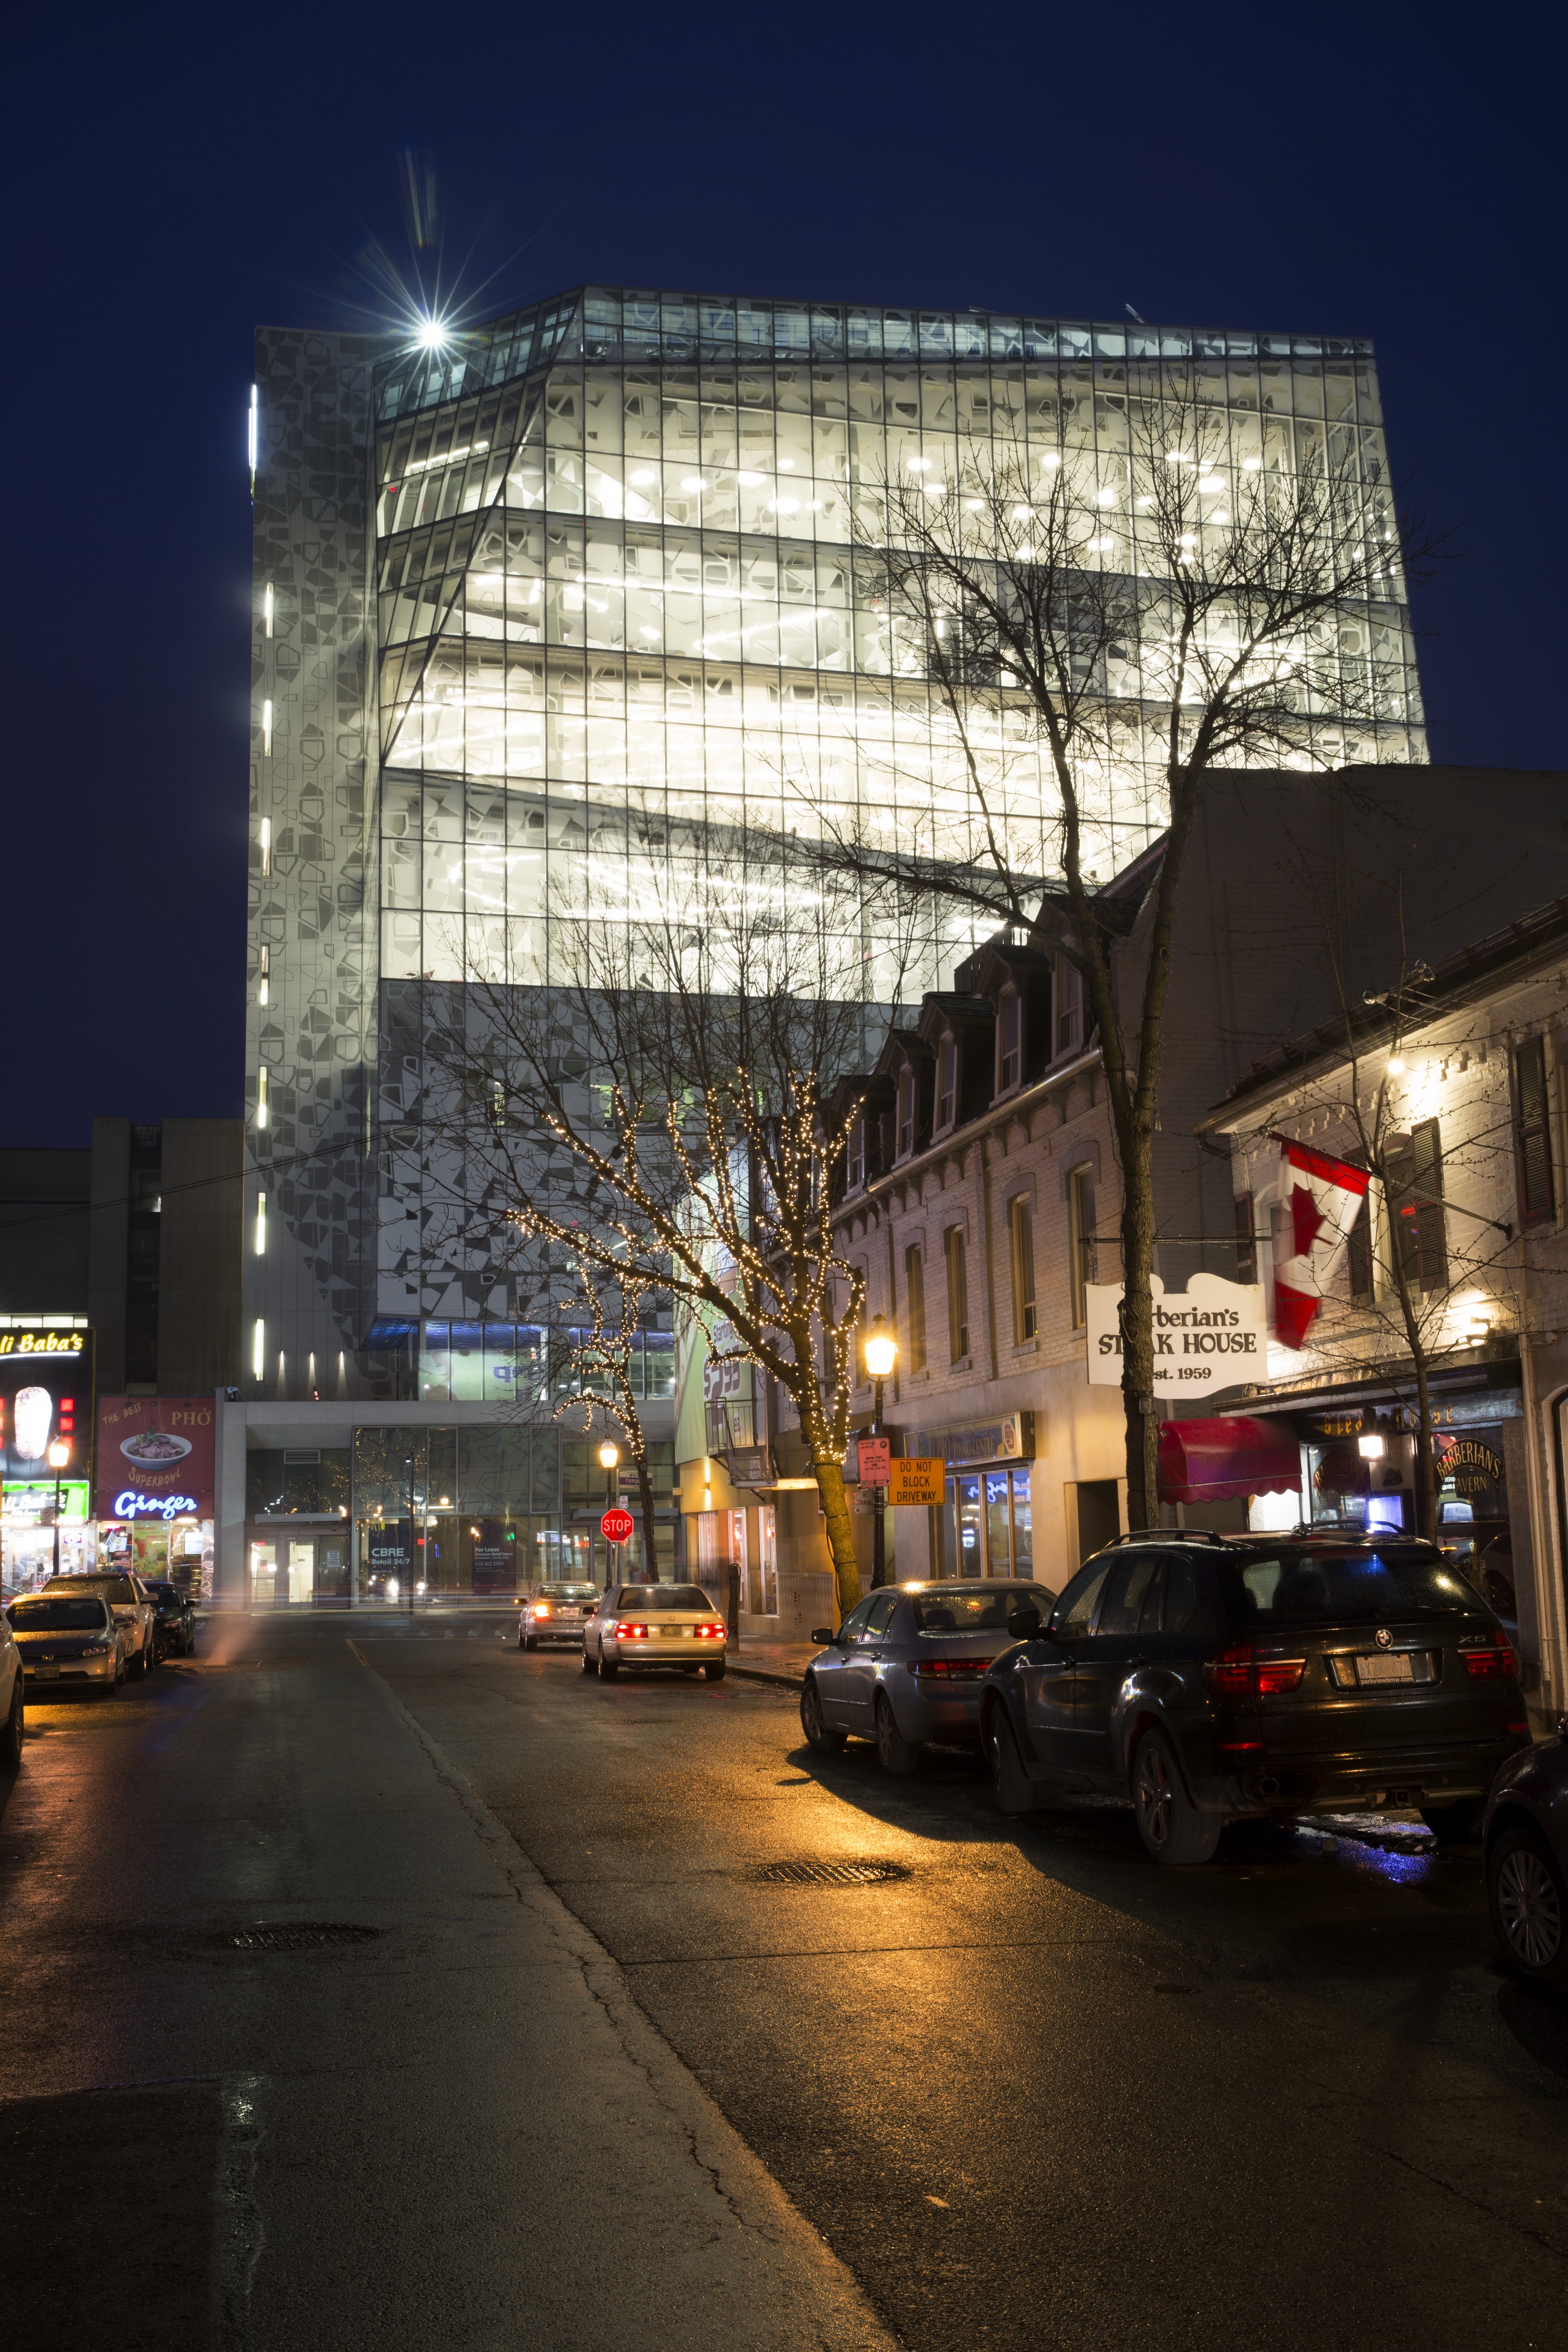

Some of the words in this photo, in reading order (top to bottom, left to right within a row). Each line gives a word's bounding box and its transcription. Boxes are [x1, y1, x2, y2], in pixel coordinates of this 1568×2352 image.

[1152, 1305, 1239, 1327] rberian's
[0, 1335, 14, 1353] li
[19, 1332, 83, 1352] Baba's
[1098, 1334, 1175, 1355] STK
[1183, 1333, 1257, 1353] HOUSE
[1177, 1367, 1212, 1380] 1959
[103, 1413, 119, 1426] THE
[123, 1402, 141, 1418] BEST
[1323, 1414, 1363, 1436] Stea
[1396, 1403, 1455, 1429] Hose
[953, 1440, 972, 1458] PHOTO
[972, 1437, 994, 1455] CENTRE
[900, 1461, 911, 1472] DO
[916, 1461, 932, 1472] NOT
[1436, 1442, 1501, 1480] BARBERIAN'S
[903, 1476, 930, 1487] BLOCK
[897, 1491, 937, 1502] DRIVEWAY
[115, 1491, 197, 1520] Ginger
[604, 1519, 631, 1532] STOP
[371, 1547, 405, 1557] CBRE
[1458, 1635, 1487, 1644] X5
[1361, 1677, 1414, 1686] parkviewbmw.com
